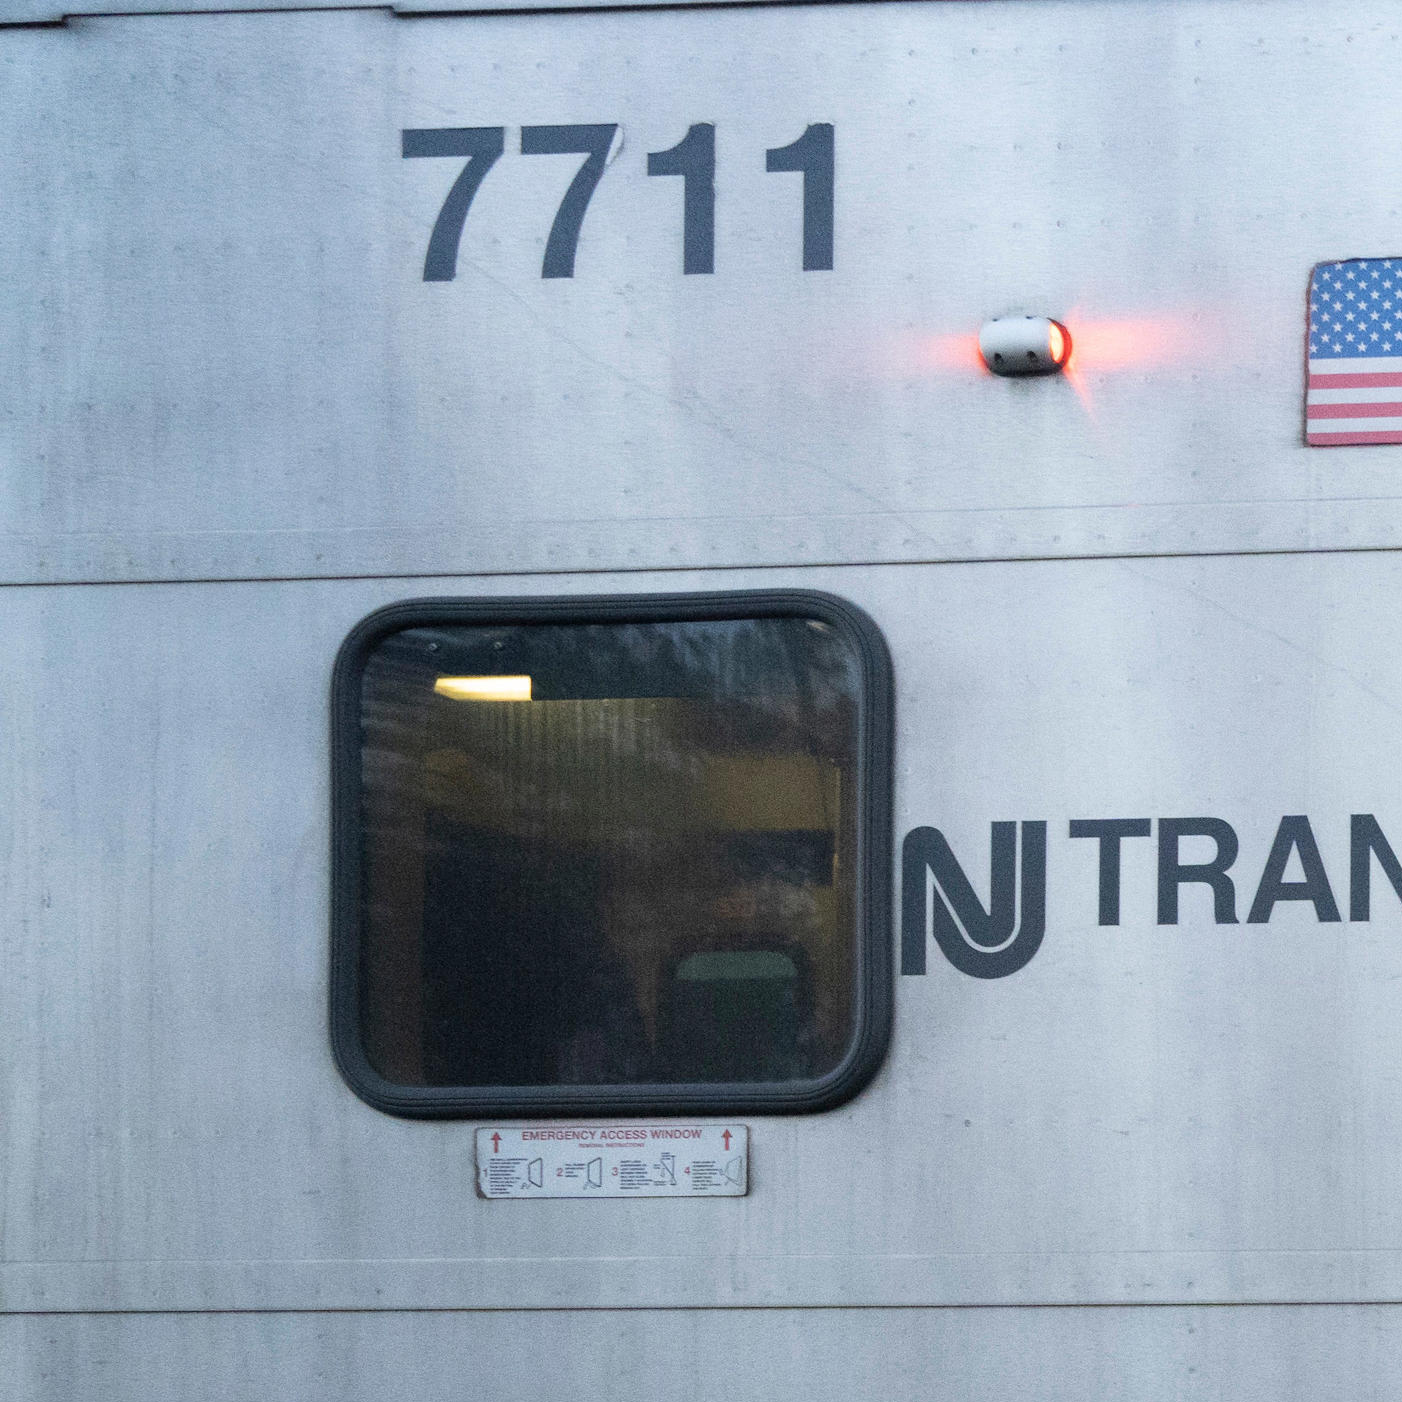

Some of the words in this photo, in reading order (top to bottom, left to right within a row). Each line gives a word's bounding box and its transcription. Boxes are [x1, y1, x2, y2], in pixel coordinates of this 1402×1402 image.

[402, 122, 834, 281] 7711
[901, 825, 1046, 979] NJ
[522, 1130, 596, 1141] EMERGENCY
[600, 1129, 647, 1139] ACCESS
[650, 1129, 702, 1139] WINDOW
[556, 1168, 563, 1177] 2
[612, 1167, 618, 1176] 3
